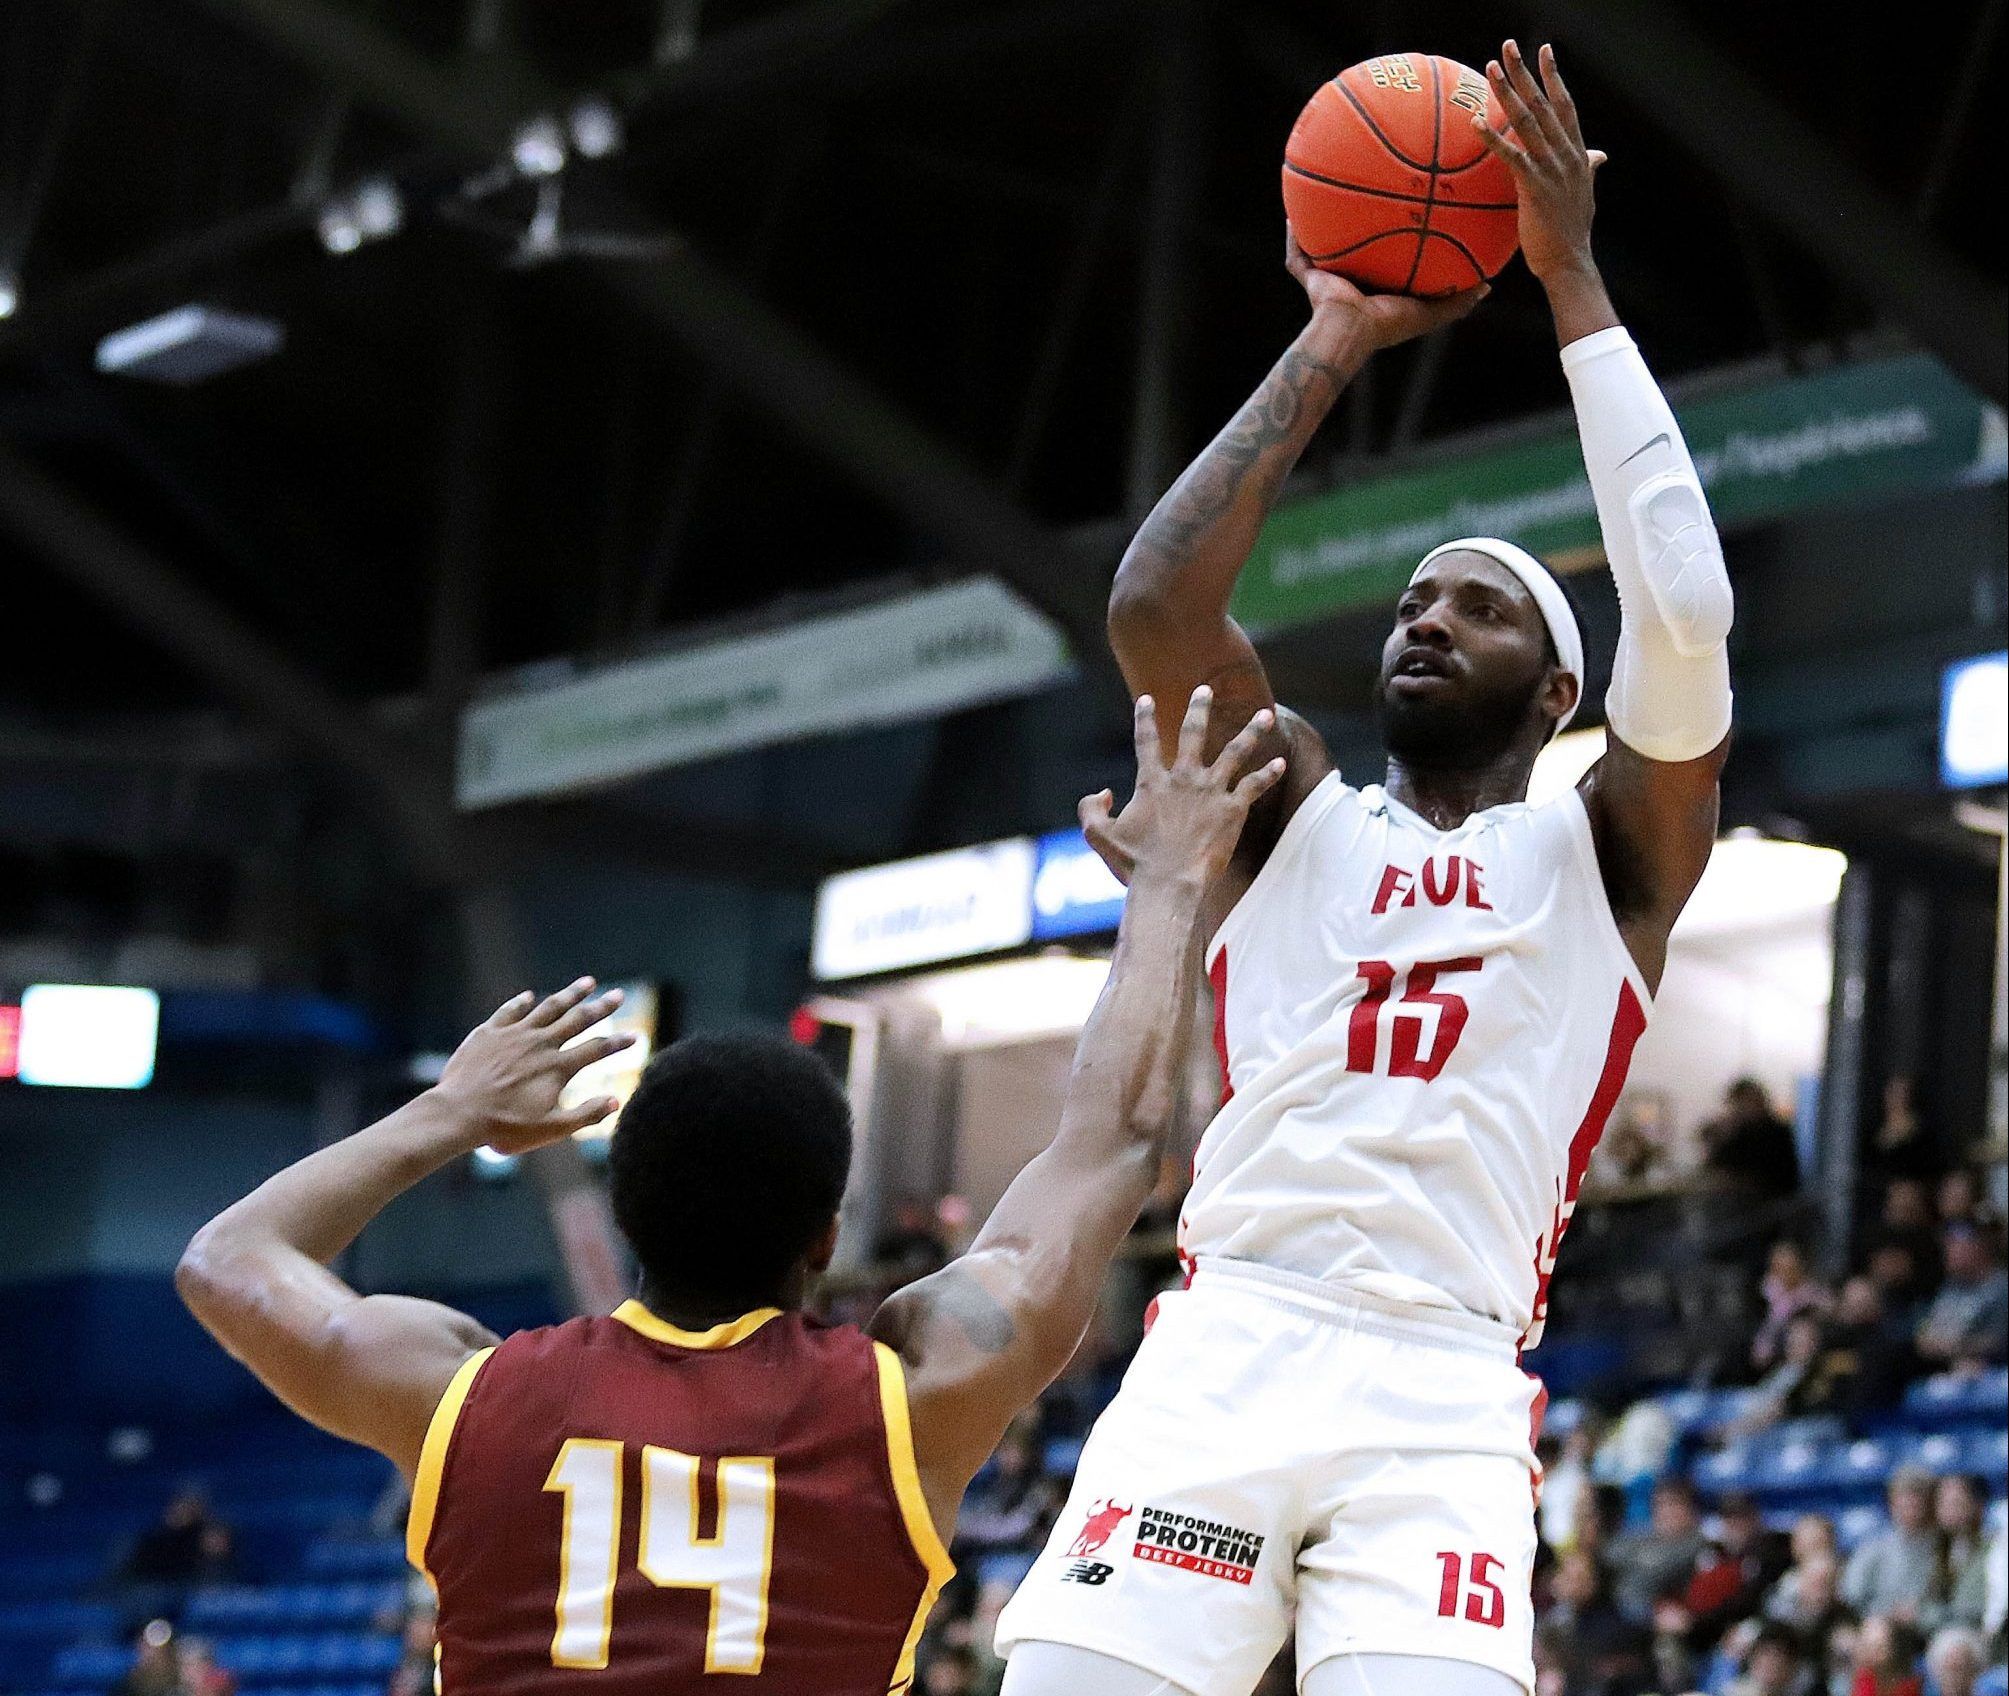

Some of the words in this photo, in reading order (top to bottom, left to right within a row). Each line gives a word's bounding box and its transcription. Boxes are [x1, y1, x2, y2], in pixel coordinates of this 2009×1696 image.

[1344, 956, 1483, 1084] 15
[541, 1437, 776, 1675] 14
[1137, 1522, 1262, 1568] PROTEIN
[1142, 1507, 1265, 1548] PERFORMANCE
[1140, 1547, 1185, 1565] BEEF
[1193, 1559, 1247, 1582] JERKY
[1436, 1551, 1505, 1630] 15
